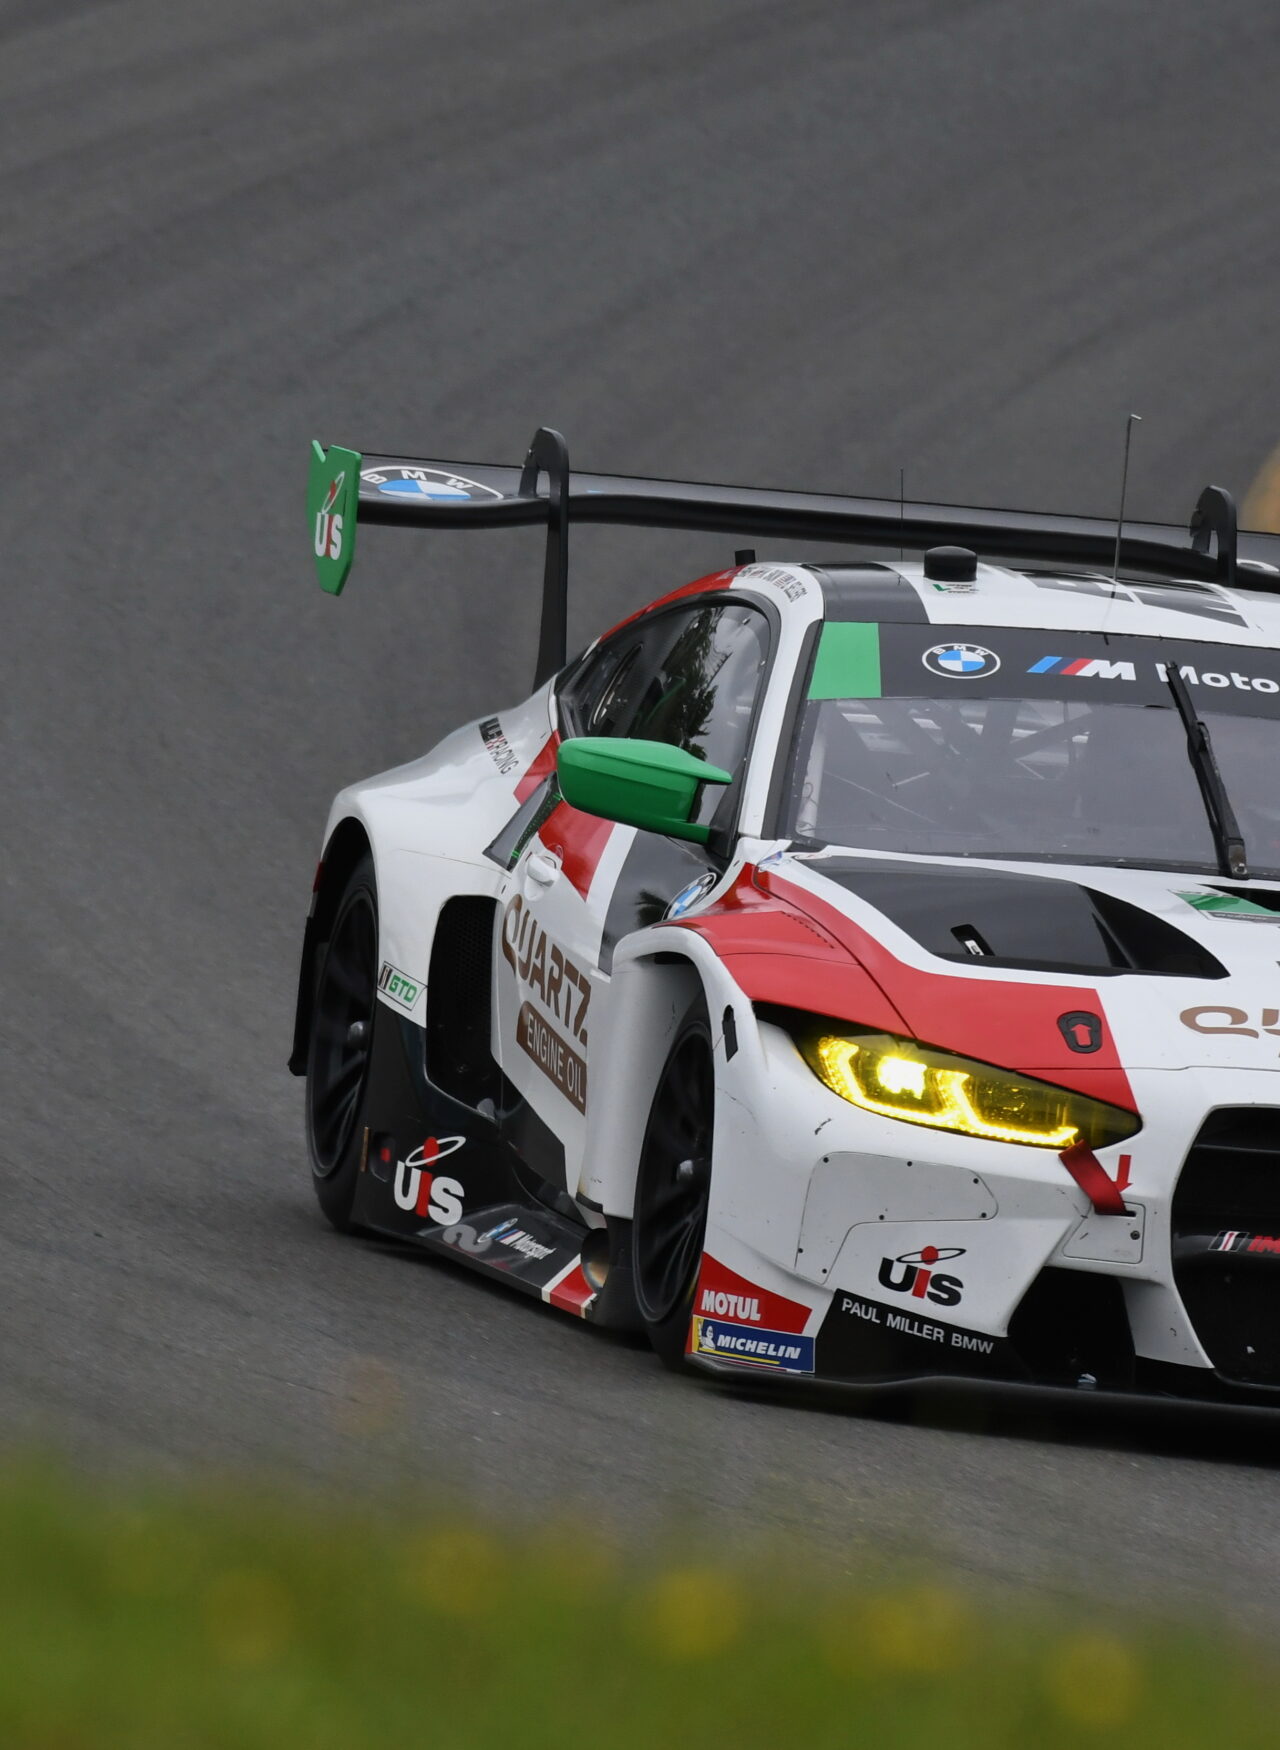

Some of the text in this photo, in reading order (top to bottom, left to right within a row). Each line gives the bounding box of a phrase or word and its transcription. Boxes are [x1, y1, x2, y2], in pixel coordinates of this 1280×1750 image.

[363, 470, 473, 489] BMW
[502, 893, 592, 1048] QUARTZ
[389, 975, 417, 1003] GTD
[526, 1012, 584, 1104] ENGINE OIL
[701, 1289, 761, 1321] MOTUL
[841, 1298, 994, 1354] PAUL MILLER BMW
[717, 1334, 801, 1359] MICHELIN
